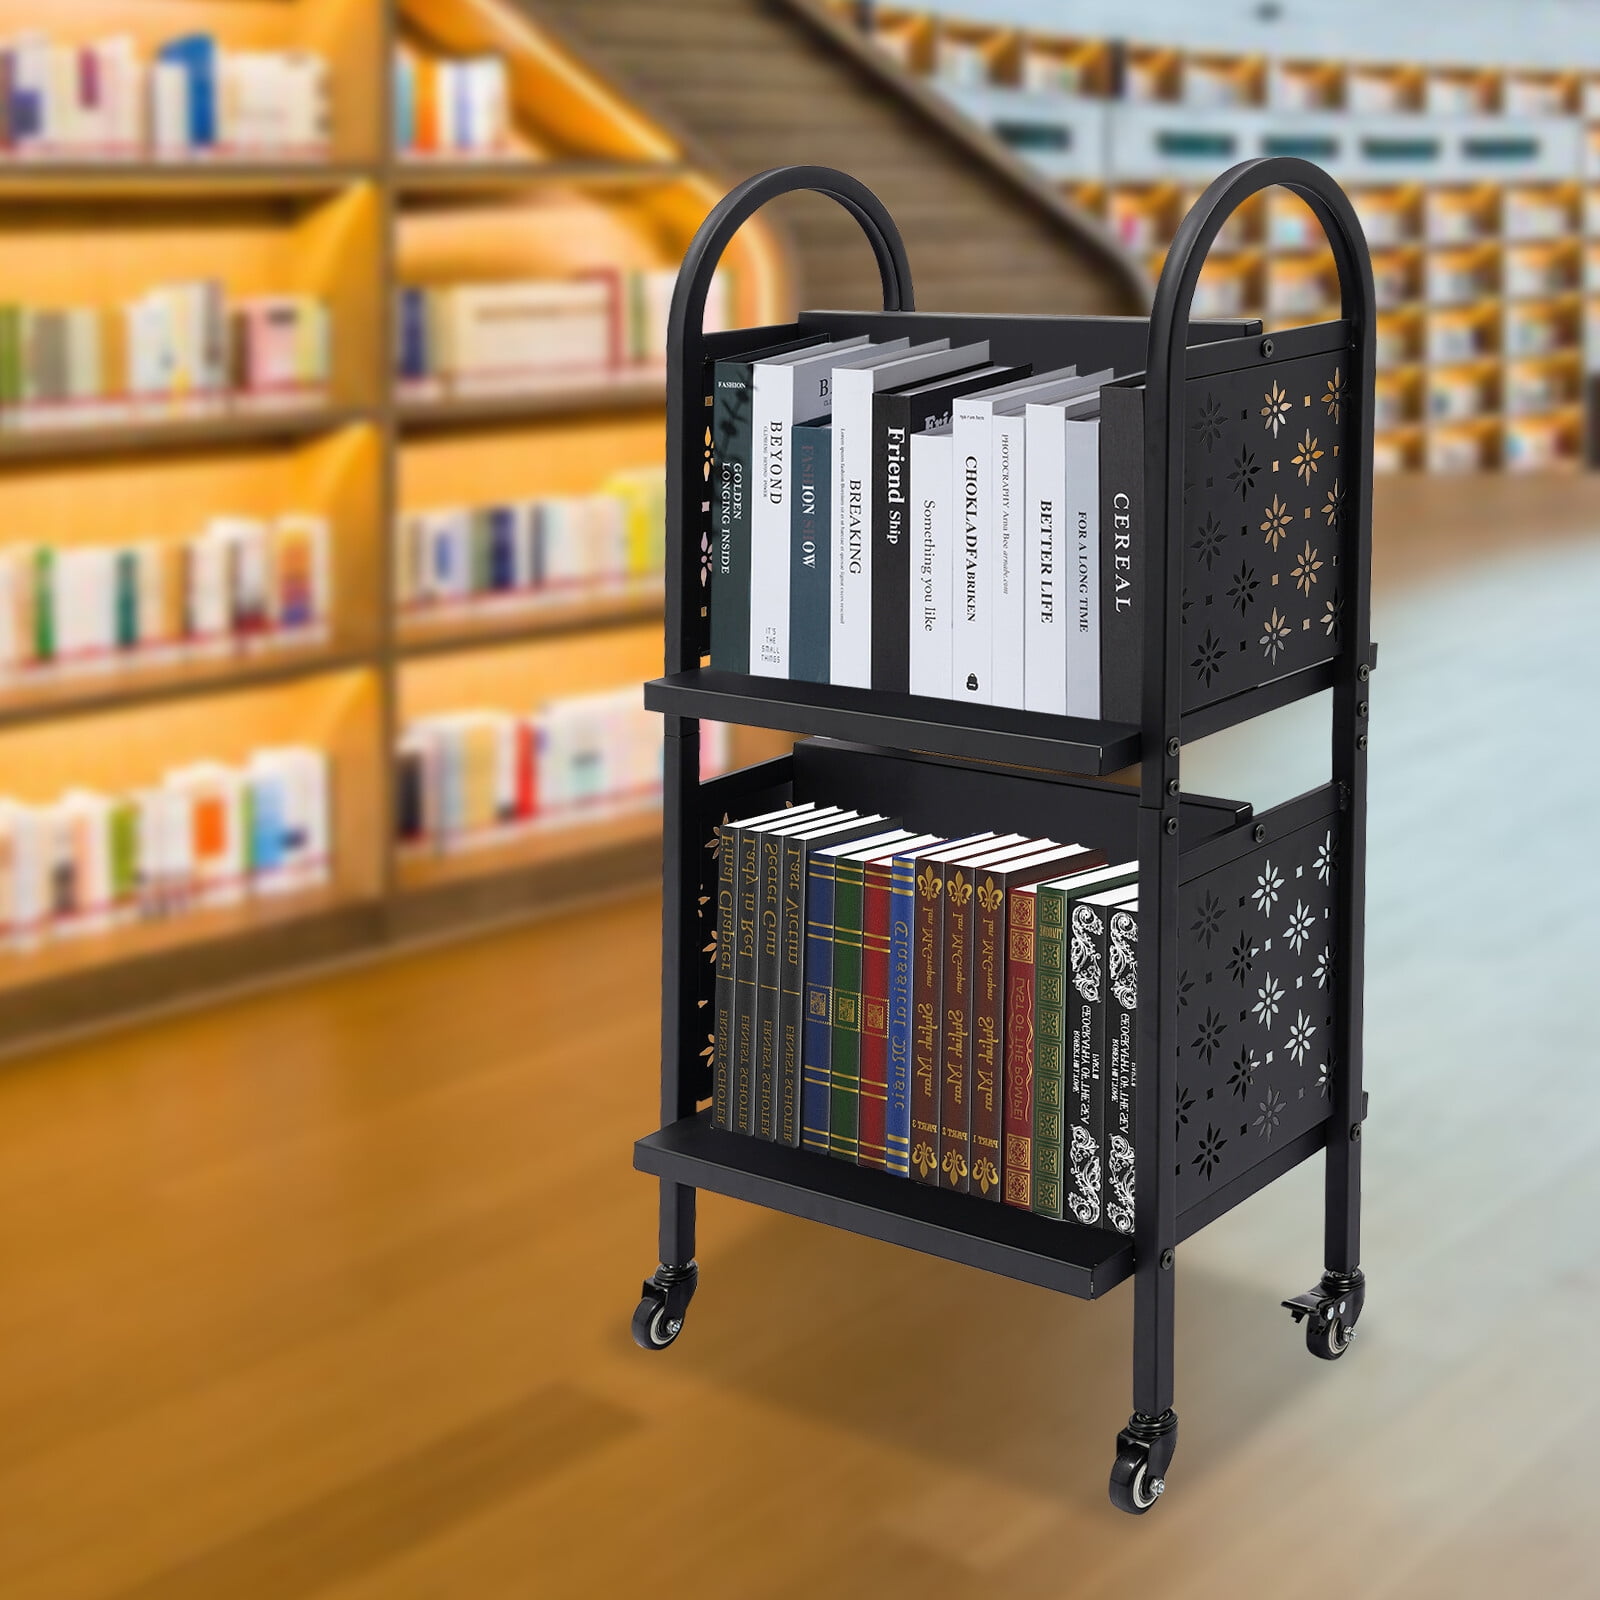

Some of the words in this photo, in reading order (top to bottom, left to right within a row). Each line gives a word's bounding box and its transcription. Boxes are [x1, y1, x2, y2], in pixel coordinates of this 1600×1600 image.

[718, 381, 746, 389] FASHION
[770, 421, 782, 504] BEYOND
[802, 445, 815, 515] FASHION
[887, 426, 905, 503] Friend
[721, 462, 731, 525] LONGING
[733, 462, 742, 519] GOLDEN
[802, 519, 816, 568] SHOW
[849, 479, 861, 574] BREAKING
[886, 510, 901, 545] Ship
[920, 500, 936, 574] Something
[965, 456, 977, 622] CHOKLADFABRIKEN
[1040, 500, 1052, 574] BETTER
[1078, 511, 1087, 538] FOR
[1078, 542, 1087, 551] A
[721, 529, 730, 574] INSIDE
[1079, 555, 1088, 594] LONG
[1113, 493, 1131, 612] CEREAL
[920, 578, 932, 602] you
[1041, 581, 1052, 623] LIFE
[1079, 597, 1088, 632] TIME
[924, 607, 936, 632] like
